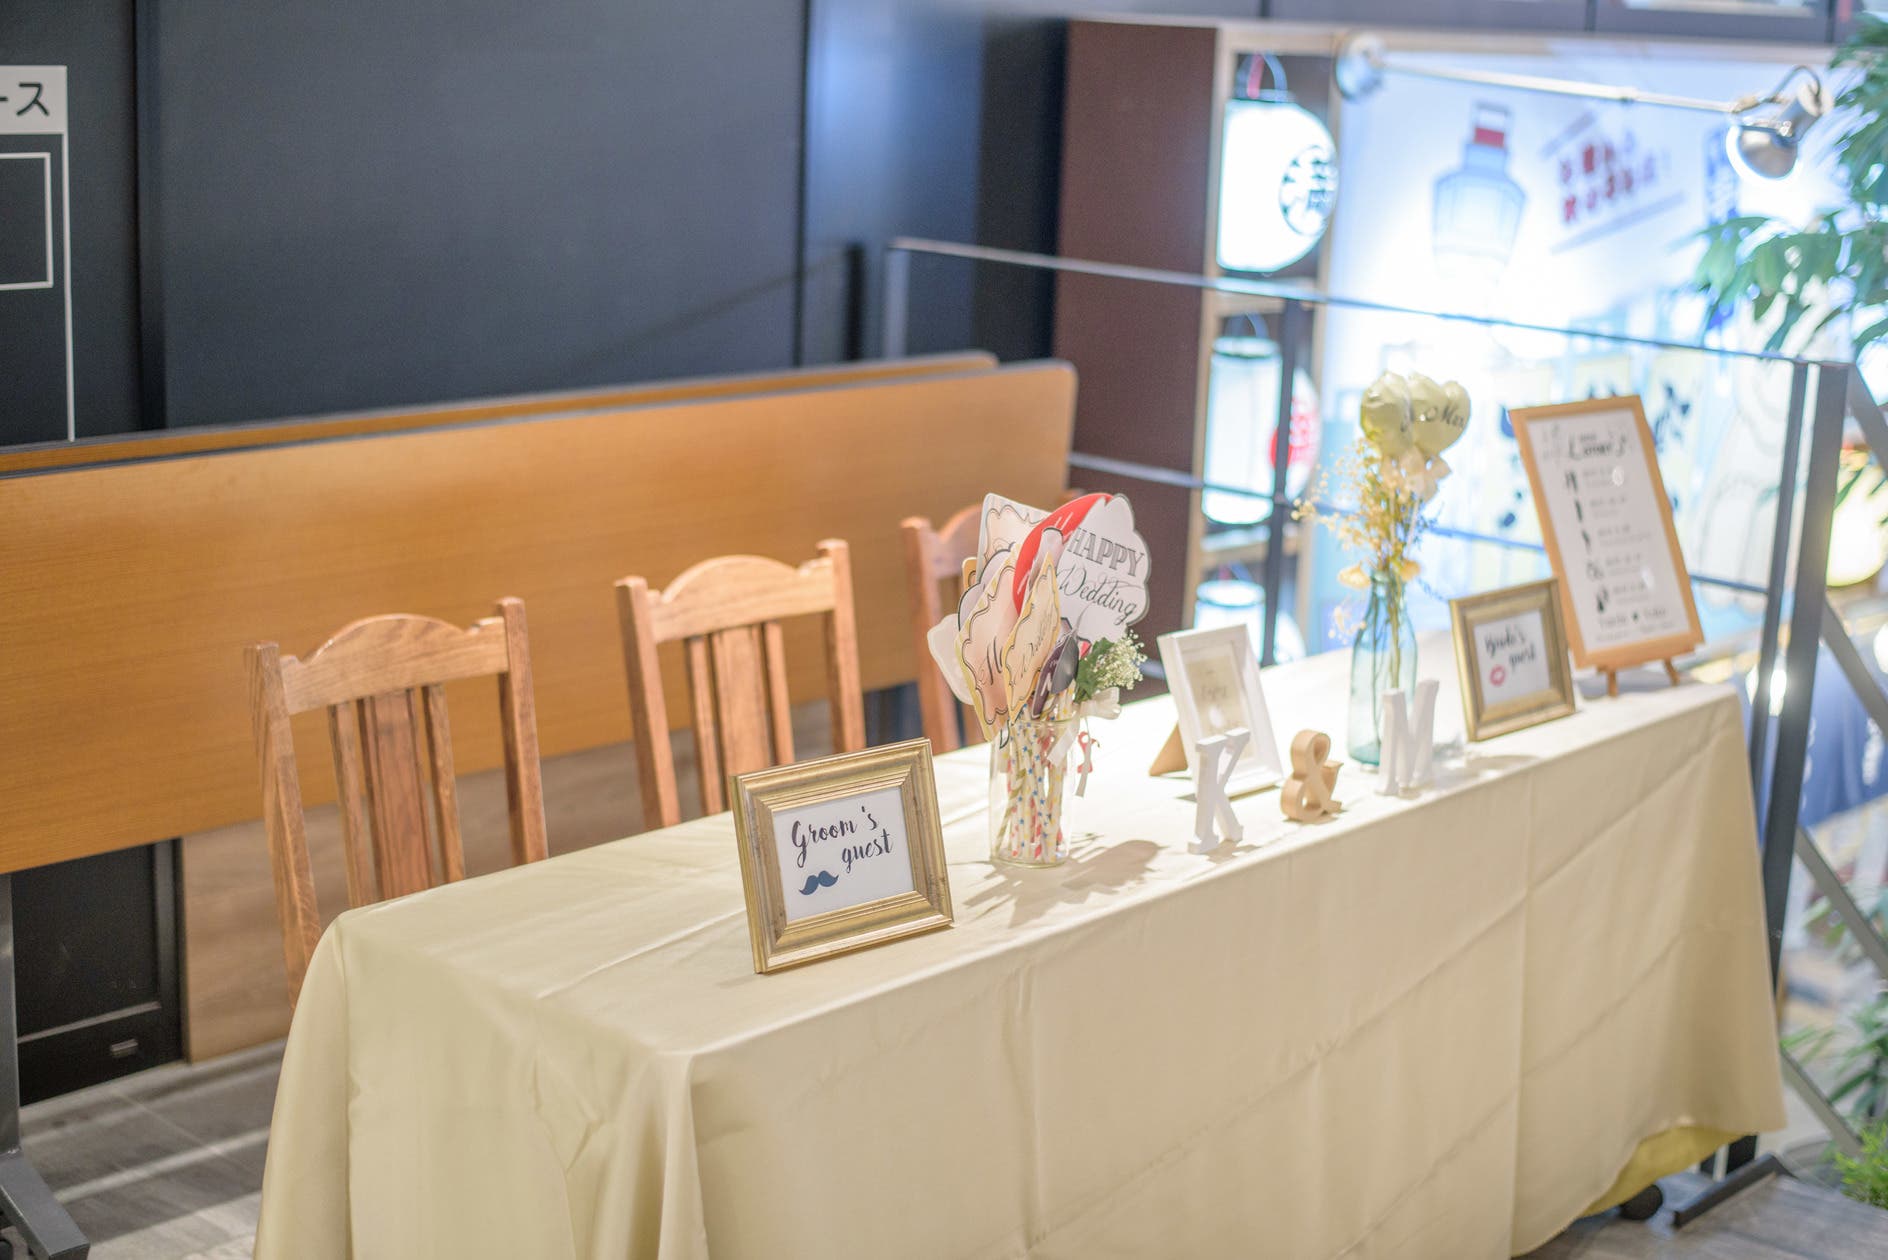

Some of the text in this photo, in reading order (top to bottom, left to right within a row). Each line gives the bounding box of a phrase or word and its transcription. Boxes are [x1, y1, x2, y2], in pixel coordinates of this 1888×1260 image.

[1067, 527, 1145, 577] HAPPY
[1056, 564, 1138, 626] Wedding
[1188, 727, 1251, 854] K
[1280, 729, 1344, 822] &
[791, 806, 880, 868] Groom's
[841, 829, 894, 874] guest
